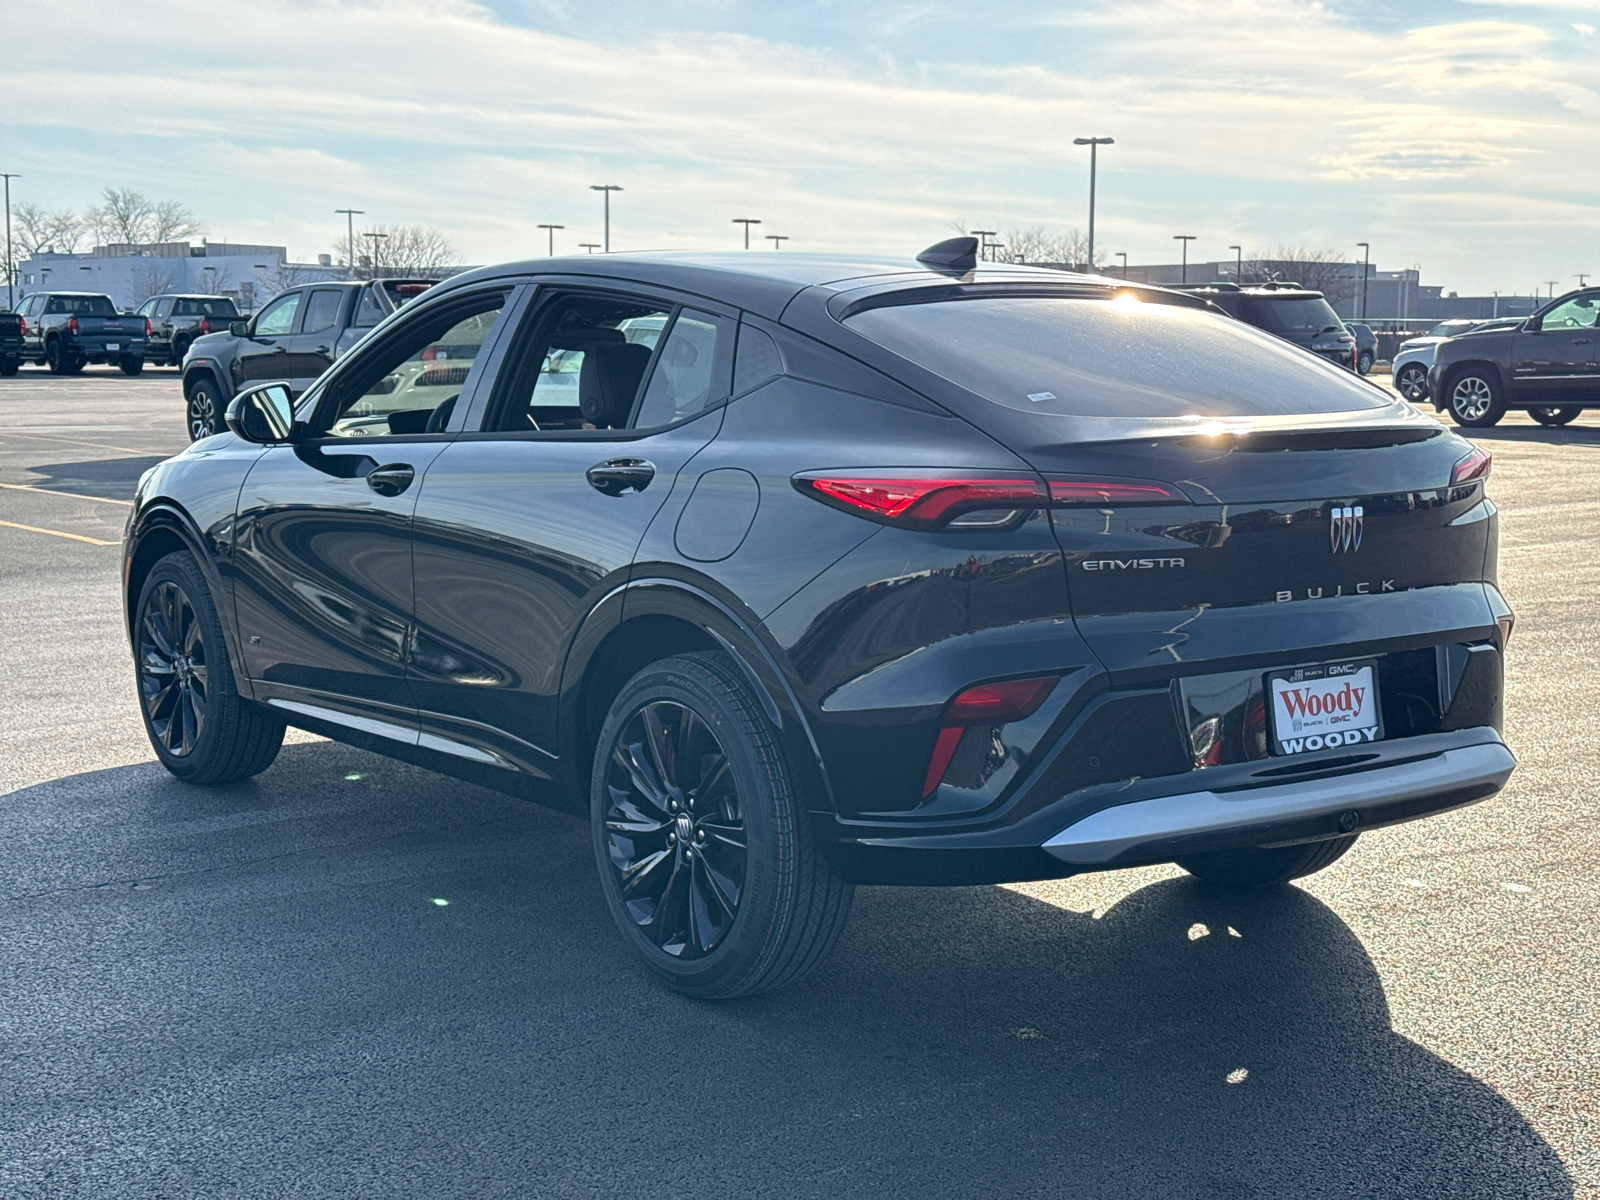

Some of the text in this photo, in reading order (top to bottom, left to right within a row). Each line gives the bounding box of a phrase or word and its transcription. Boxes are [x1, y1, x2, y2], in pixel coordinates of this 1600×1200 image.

[1082, 557, 1185, 571] ENVISTA
[1276, 579, 1394, 603] BUICK
[1329, 664, 1354, 675] GMC
[1279, 682, 1366, 719] Woody
[1330, 714, 1351, 724] GMC
[1281, 727, 1378, 755] WOODY
